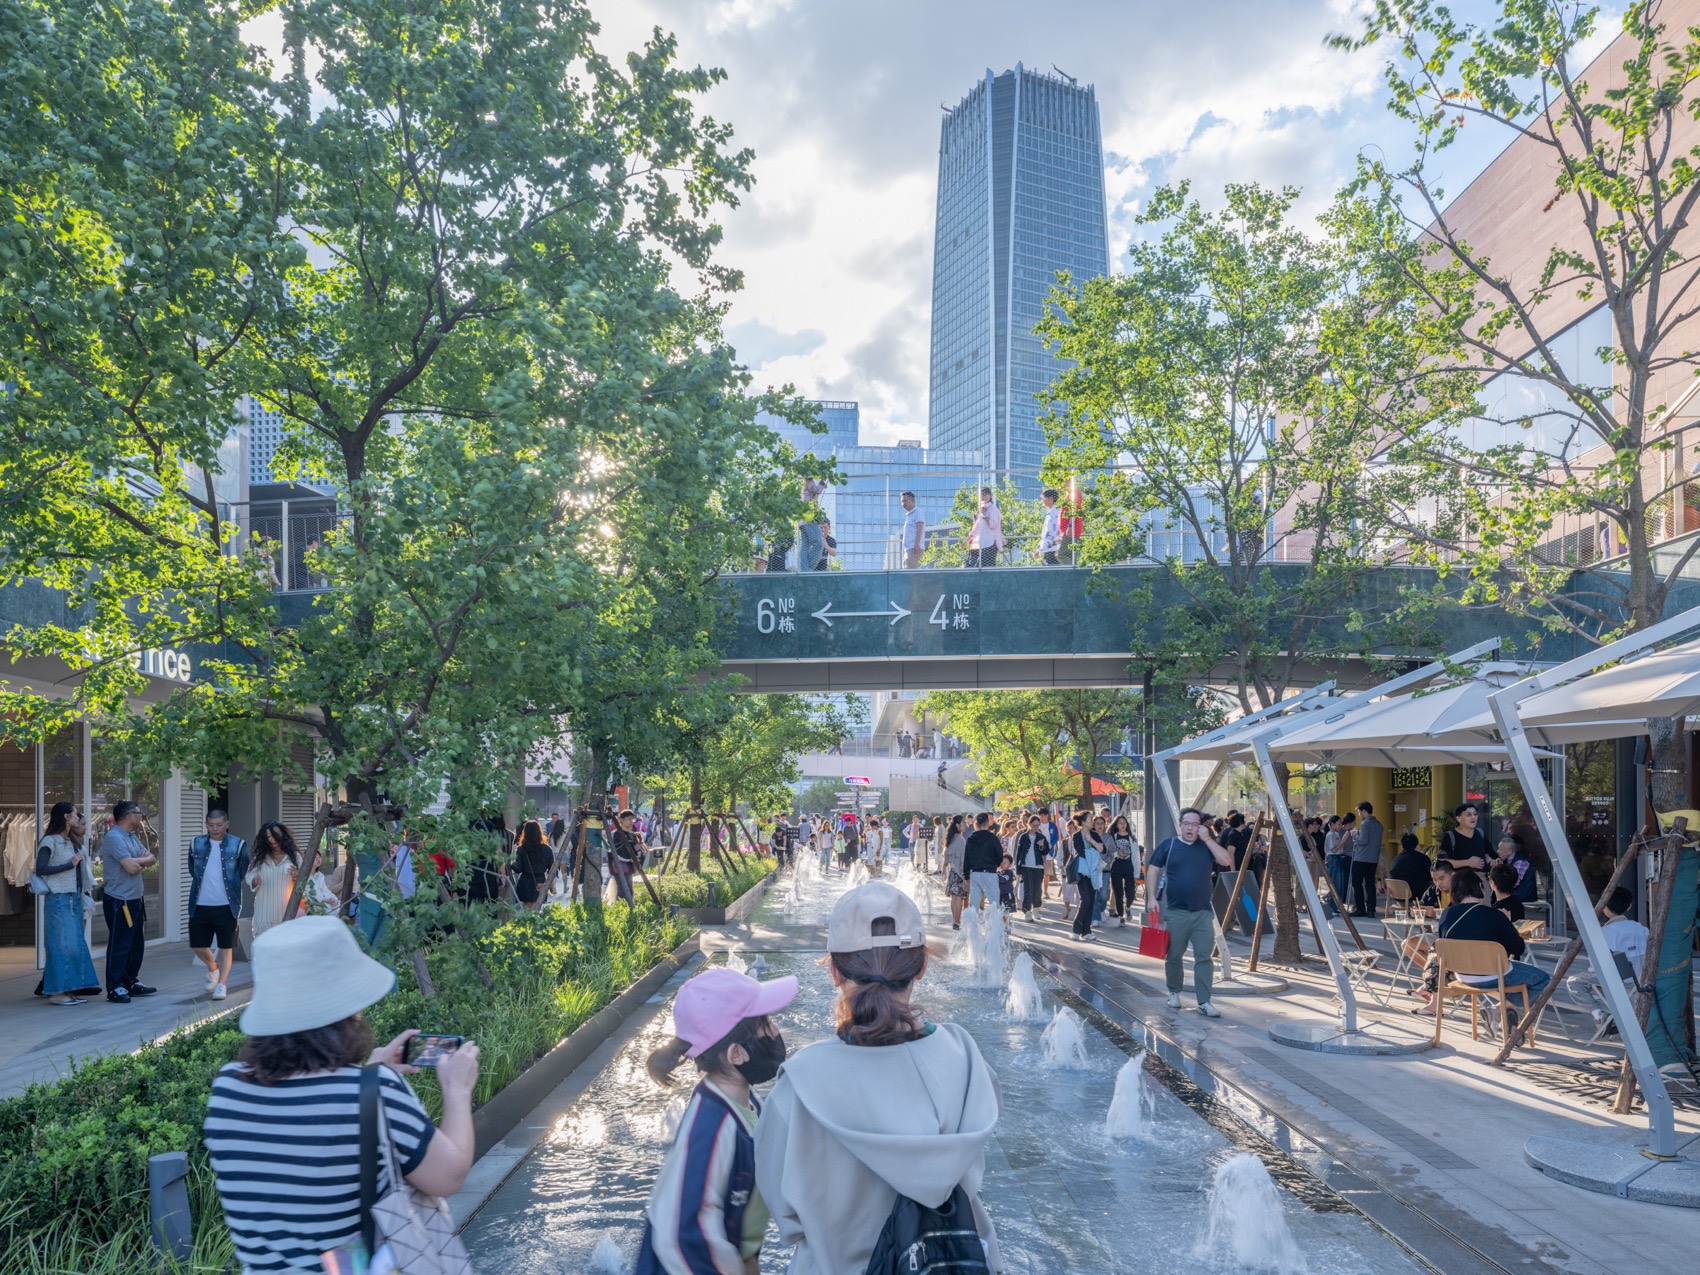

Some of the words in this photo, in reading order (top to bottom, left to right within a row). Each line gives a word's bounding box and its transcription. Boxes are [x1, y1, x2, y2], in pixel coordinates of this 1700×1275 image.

[757, 598, 775, 634] 6
[929, 594, 950, 630] 4
[952, 612, 970, 630] 栋
[778, 615, 795, 634] 栋
[1394, 772, 1430, 787] 16:21:24
